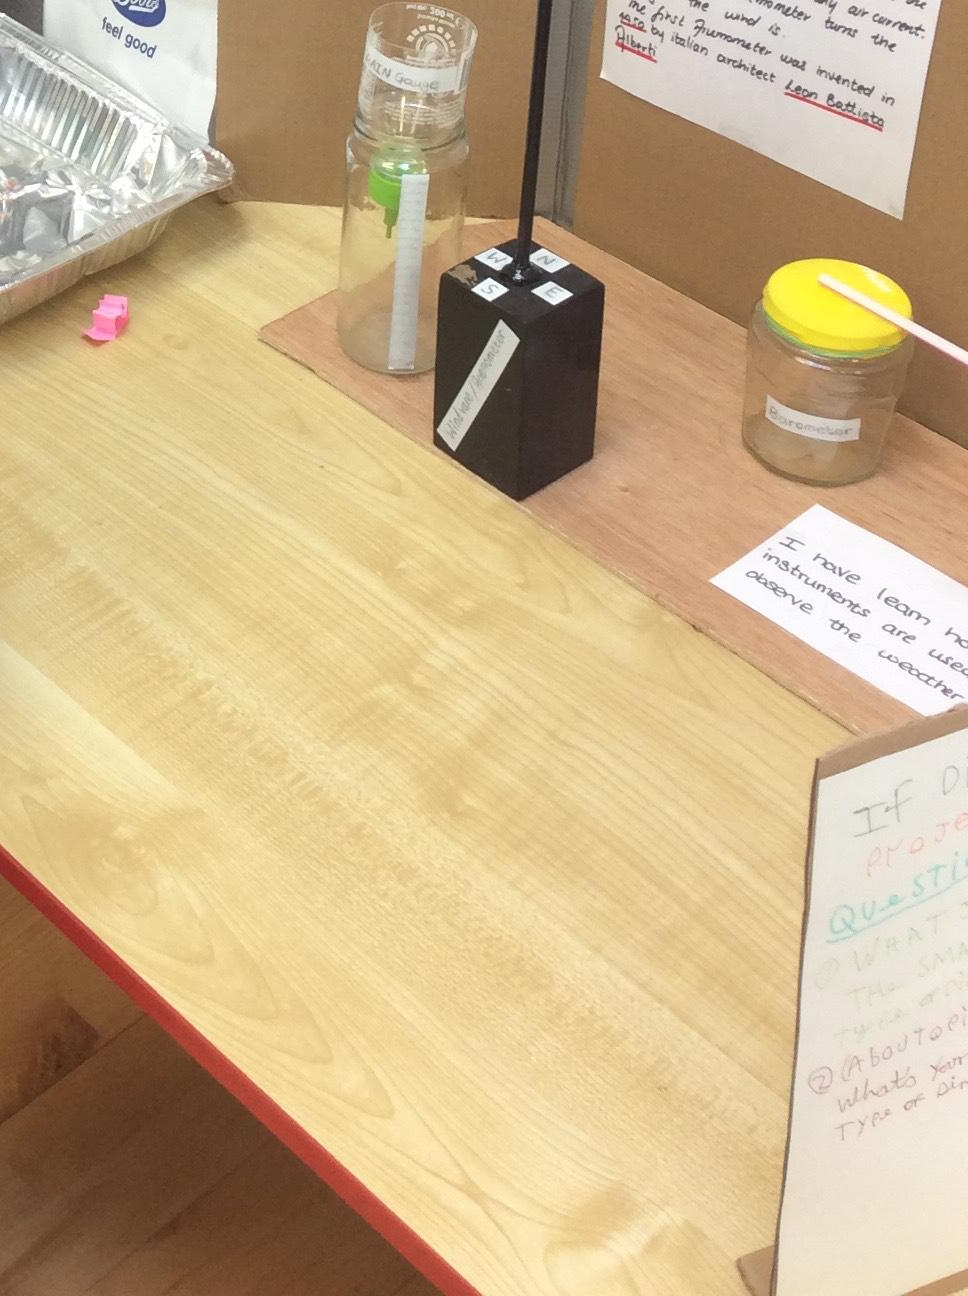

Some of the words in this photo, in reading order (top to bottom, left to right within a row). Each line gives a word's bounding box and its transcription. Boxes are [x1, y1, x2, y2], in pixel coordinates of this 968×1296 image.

[724, 10, 761, 28] wind
[847, 4, 869, 18] air
[101, 16, 123, 40] feel
[124, 33, 157, 59] good
[824, 16, 859, 39] turns
[871, 33, 897, 53] the
[651, 24, 665, 43] by
[716, 53, 777, 83] architect
[785, 79, 818, 100] Leon
[780, 53, 807, 71] was
[816, 66, 876, 98] invented
[881, 93, 895, 107] in
[485, 252, 506, 267] W
[535, 255, 557, 270] N
[481, 283, 499, 295] S
[544, 286, 565, 298] E
[812, 553, 862, 585] have
[762, 547, 871, 618] instruments
[881, 623, 917, 645] are
[745, 569, 814, 615] observe
[829, 618, 863, 643] the
[878, 650, 965, 700] weather
